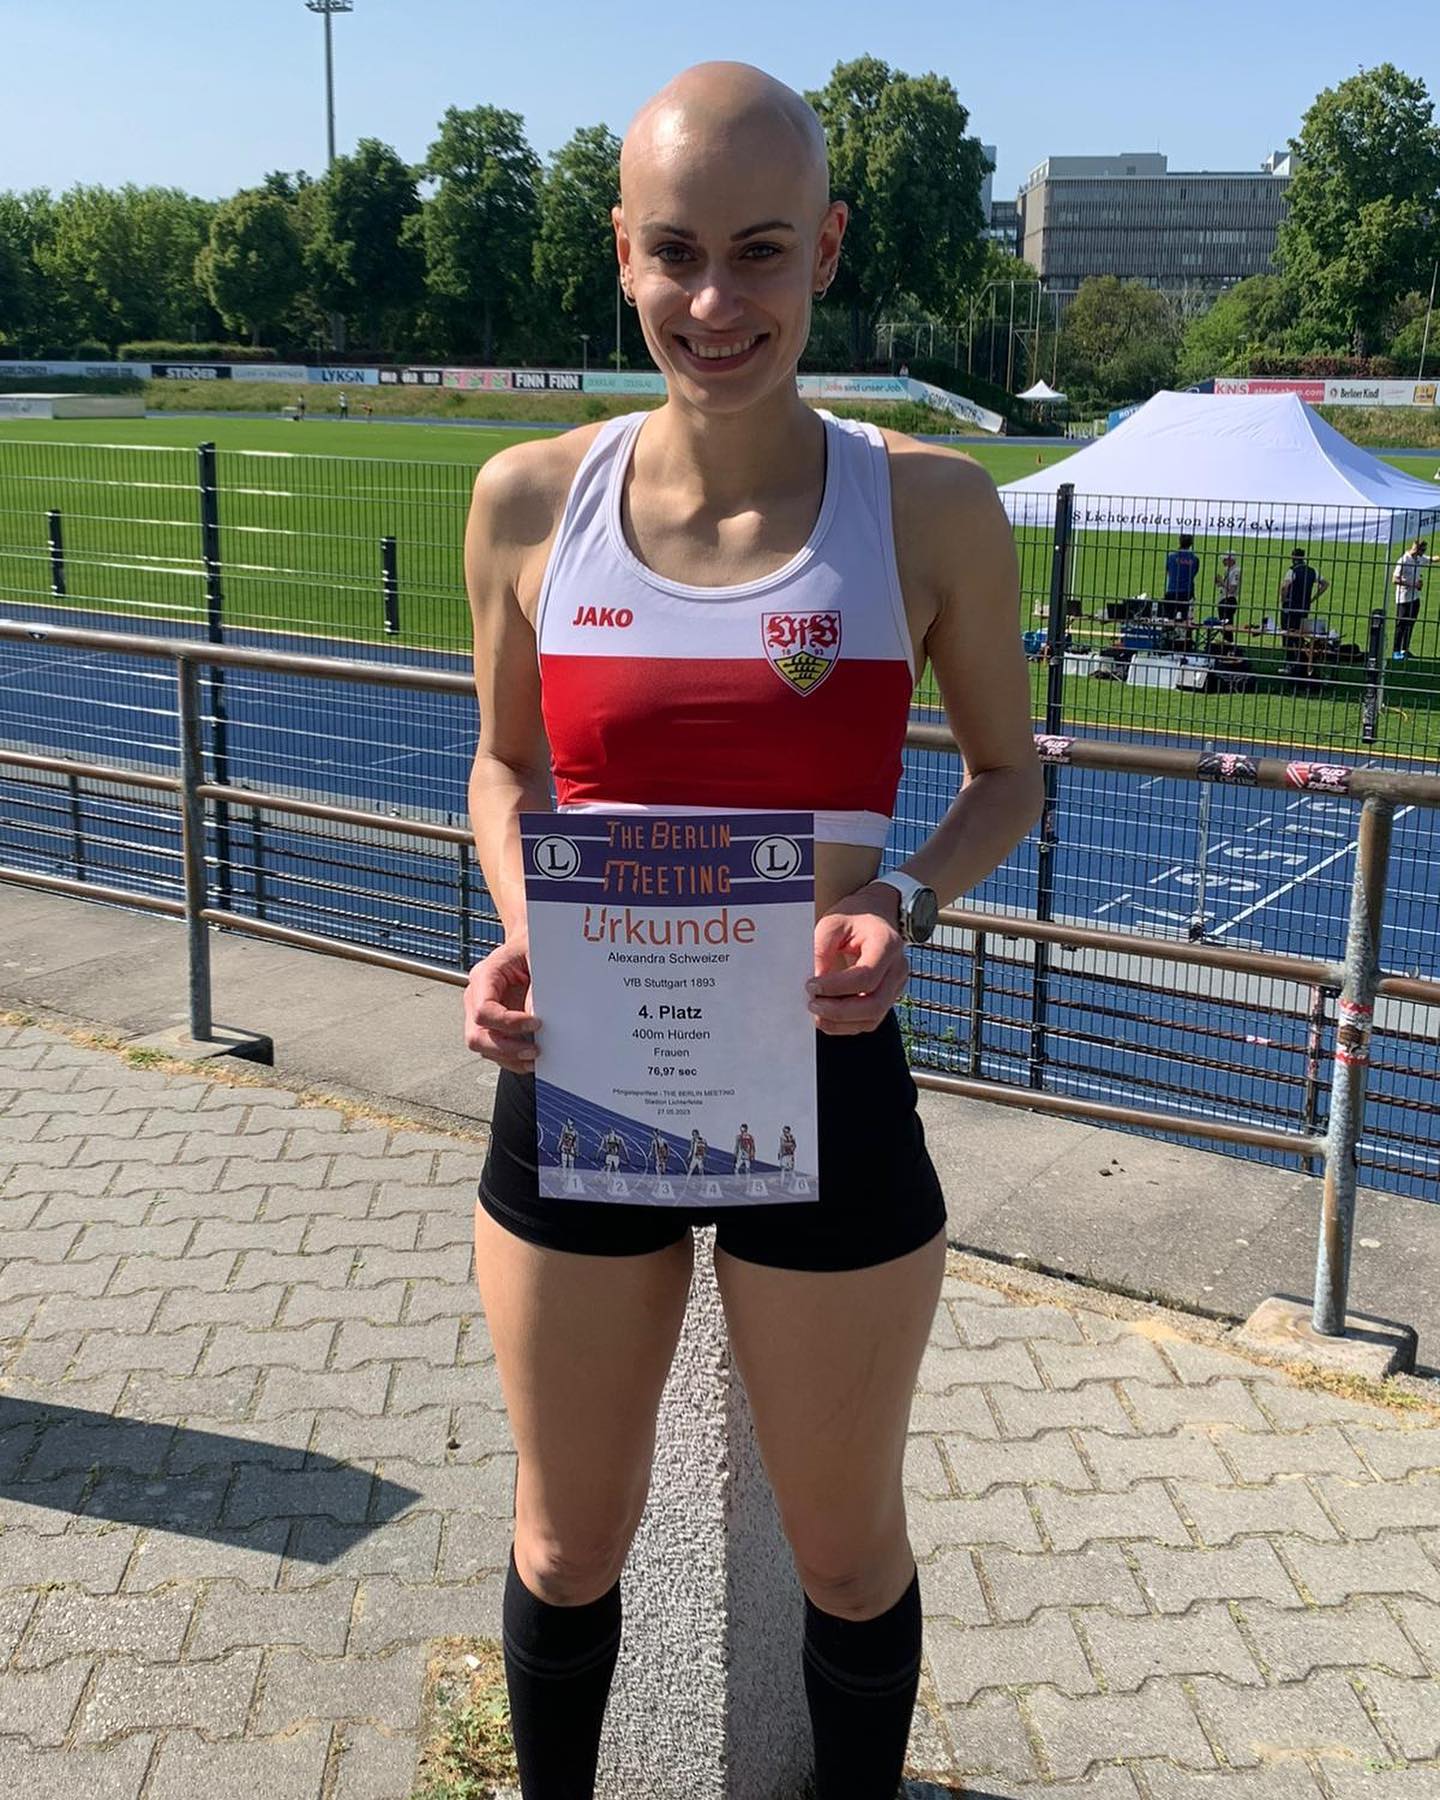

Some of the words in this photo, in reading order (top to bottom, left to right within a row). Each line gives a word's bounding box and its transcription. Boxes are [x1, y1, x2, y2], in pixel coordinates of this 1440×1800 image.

[516, 374, 545, 388] FINN
[550, 375, 579, 389] FINN
[844, 383, 860, 392] sind
[861, 384, 883, 392] unser
[1216, 384, 1247, 395] KNS
[1086, 510, 1171, 526] Lichterfelde
[1176, 517, 1202, 527] von
[1209, 516, 1246, 529] 1887
[1250, 519, 1279, 531] e.V.
[573, 606, 633, 628] JAKO
[607, 821, 644, 849] THE
[651, 822, 731, 849] BERLIN
[547, 844, 570, 871] L
[766, 844, 790, 871] L
[603, 860, 731, 894] MEETING
[583, 907, 756, 945] Urkunde
[608, 952, 665, 964] Alexandra
[669, 953, 730, 964] Schweizer
[623, 977, 641, 987] VfB
[644, 977, 687, 990] Stuttgart
[692, 978, 715, 987] 1893
[638, 1005, 653, 1019] 4.
[659, 1005, 702, 1020] Platz
[632, 1029, 664, 1039] 400m
[668, 1029, 710, 1040] Hürden
[654, 1047, 690, 1057] Frauen
[648, 1066, 675, 1077] 76,97
[679, 1068, 697, 1076] sec
